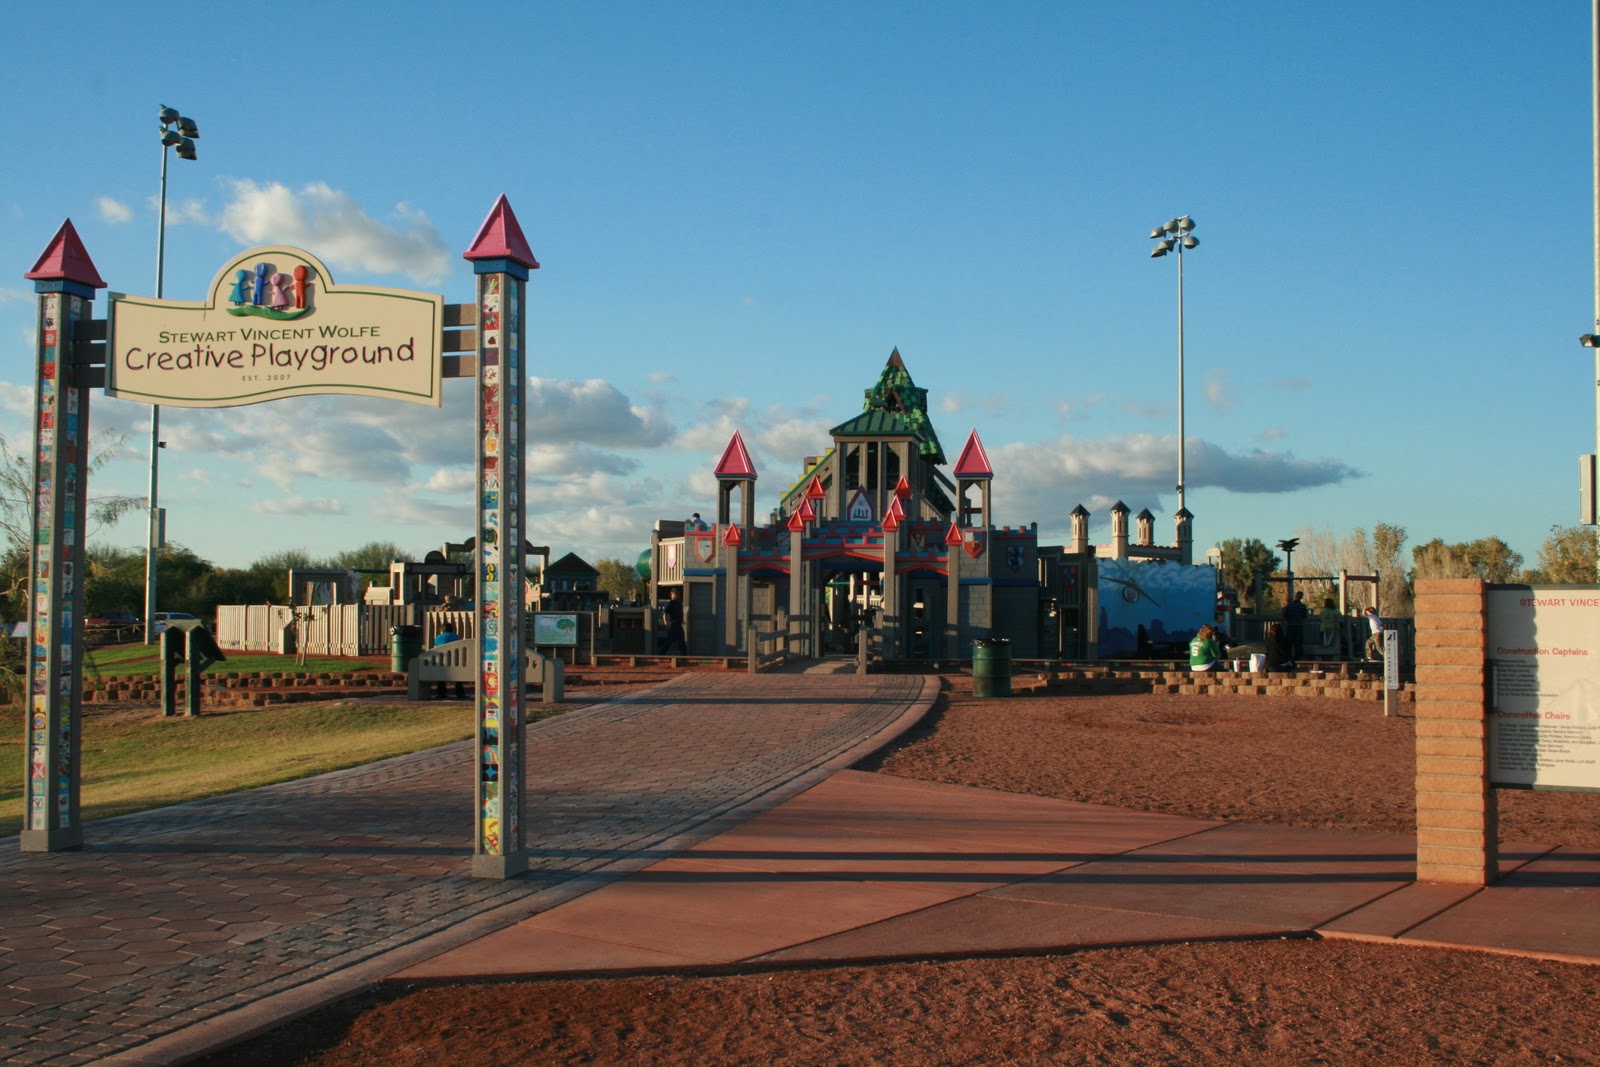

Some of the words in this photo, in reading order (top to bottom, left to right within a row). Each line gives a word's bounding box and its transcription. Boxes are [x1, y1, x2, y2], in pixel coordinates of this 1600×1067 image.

[158, 331, 237, 344] STEWART
[240, 328, 315, 341] VINCENT
[318, 325, 381, 338] WOLFE
[125, 343, 244, 371] Creative
[251, 336, 414, 371] Playground
[1519, 598, 1566, 607] STEWART
[1496, 647, 1550, 656] Construction
[1552, 647, 1589, 657] Captains
[1497, 710, 1542, 719] Committee
[1544, 711, 1571, 720] Chairs
